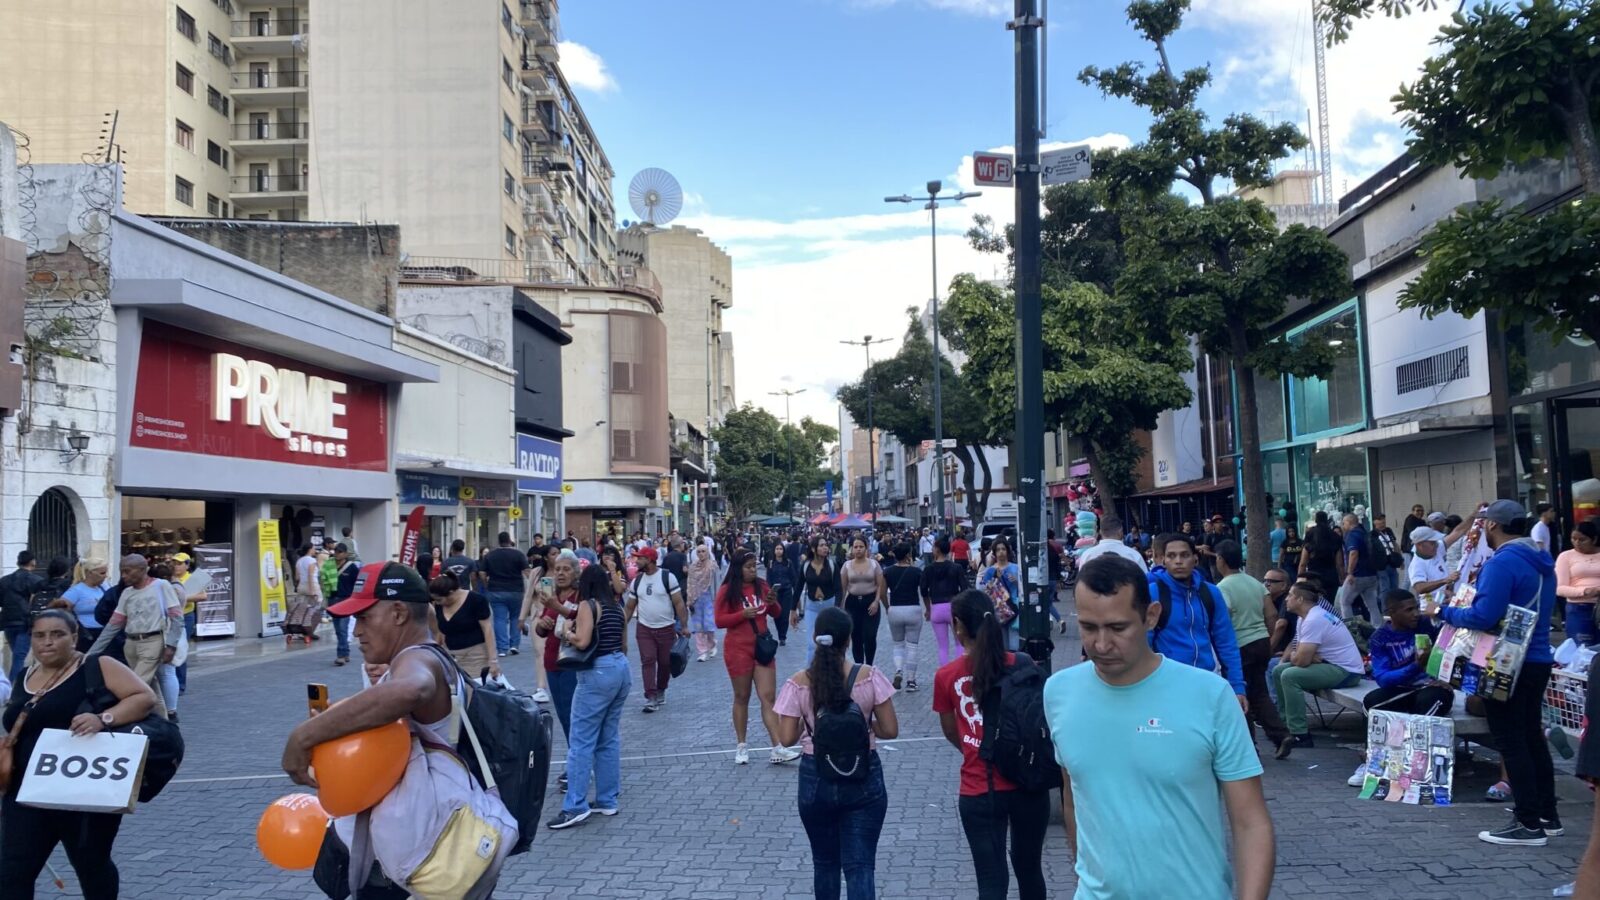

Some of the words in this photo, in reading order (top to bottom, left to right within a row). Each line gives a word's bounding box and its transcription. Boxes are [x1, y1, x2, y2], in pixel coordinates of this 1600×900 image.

[212, 352, 348, 440] PRIME
[287, 435, 347, 457] shoes
[520, 450, 560, 479] RAYTOP
[402, 529, 418, 566] RIME
[963, 734, 982, 748] BAL
[34, 753, 131, 781] BOSS
